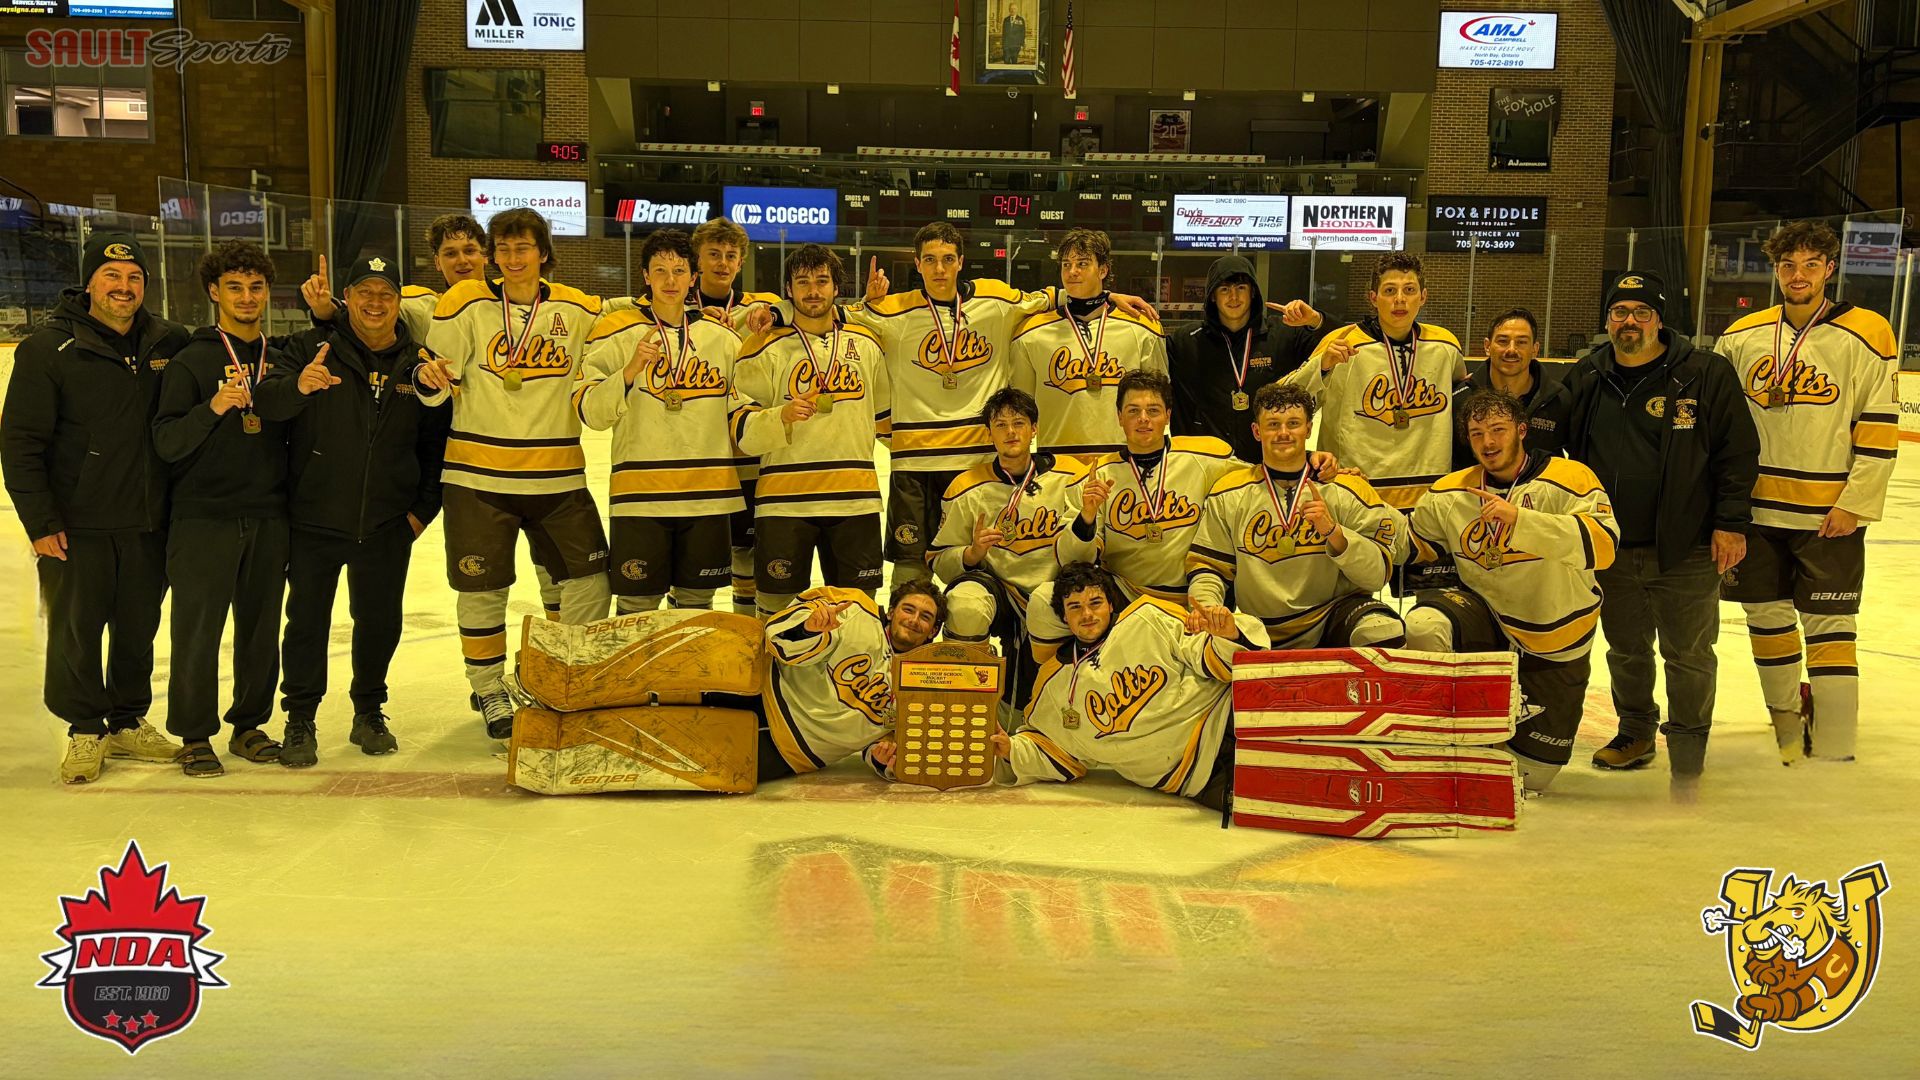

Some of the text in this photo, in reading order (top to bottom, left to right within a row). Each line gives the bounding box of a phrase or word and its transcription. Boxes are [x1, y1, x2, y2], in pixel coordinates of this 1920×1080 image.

[533, 16, 576, 28] IONIC
[475, 29, 525, 39] MILLER
[1473, 23, 1527, 37] AMJ
[1469, 59, 1524, 67] 705-472-8910
[1503, 97, 1528, 116] FOX
[1524, 94, 1557, 117] HOLE
[1161, 125, 1178, 139] 20
[551, 144, 580, 160] 9:05
[879, 189, 900, 197] PLAYER
[492, 196, 582, 208] transcanada
[993, 195, 1031, 215] 9:04
[631, 199, 710, 224] Brandt
[946, 209, 970, 219] HOME
[1040, 210, 1065, 220] GUEST
[1303, 205, 1393, 228] NORTHERN
[1435, 206, 1539, 220] FOX & FIDDLE
[1213, 216, 1244, 225] AUTO
[1319, 220, 1376, 228] HONDA
[1469, 230, 1502, 238] SPENCER
[1456, 240, 1515, 249] 705476-3699
[549, 312, 569, 337] A
[844, 338, 861, 361] A
[1049, 345, 1122, 387] Cots
[1361, 373, 1438, 418] Colts
[699, 566, 732, 576] BAUE
[1810, 592, 1858, 601] BAUER
[585, 616, 650, 635] BAUER
[1084, 664, 1153, 734] Colts
[1528, 730, 1574, 748] BAUER
